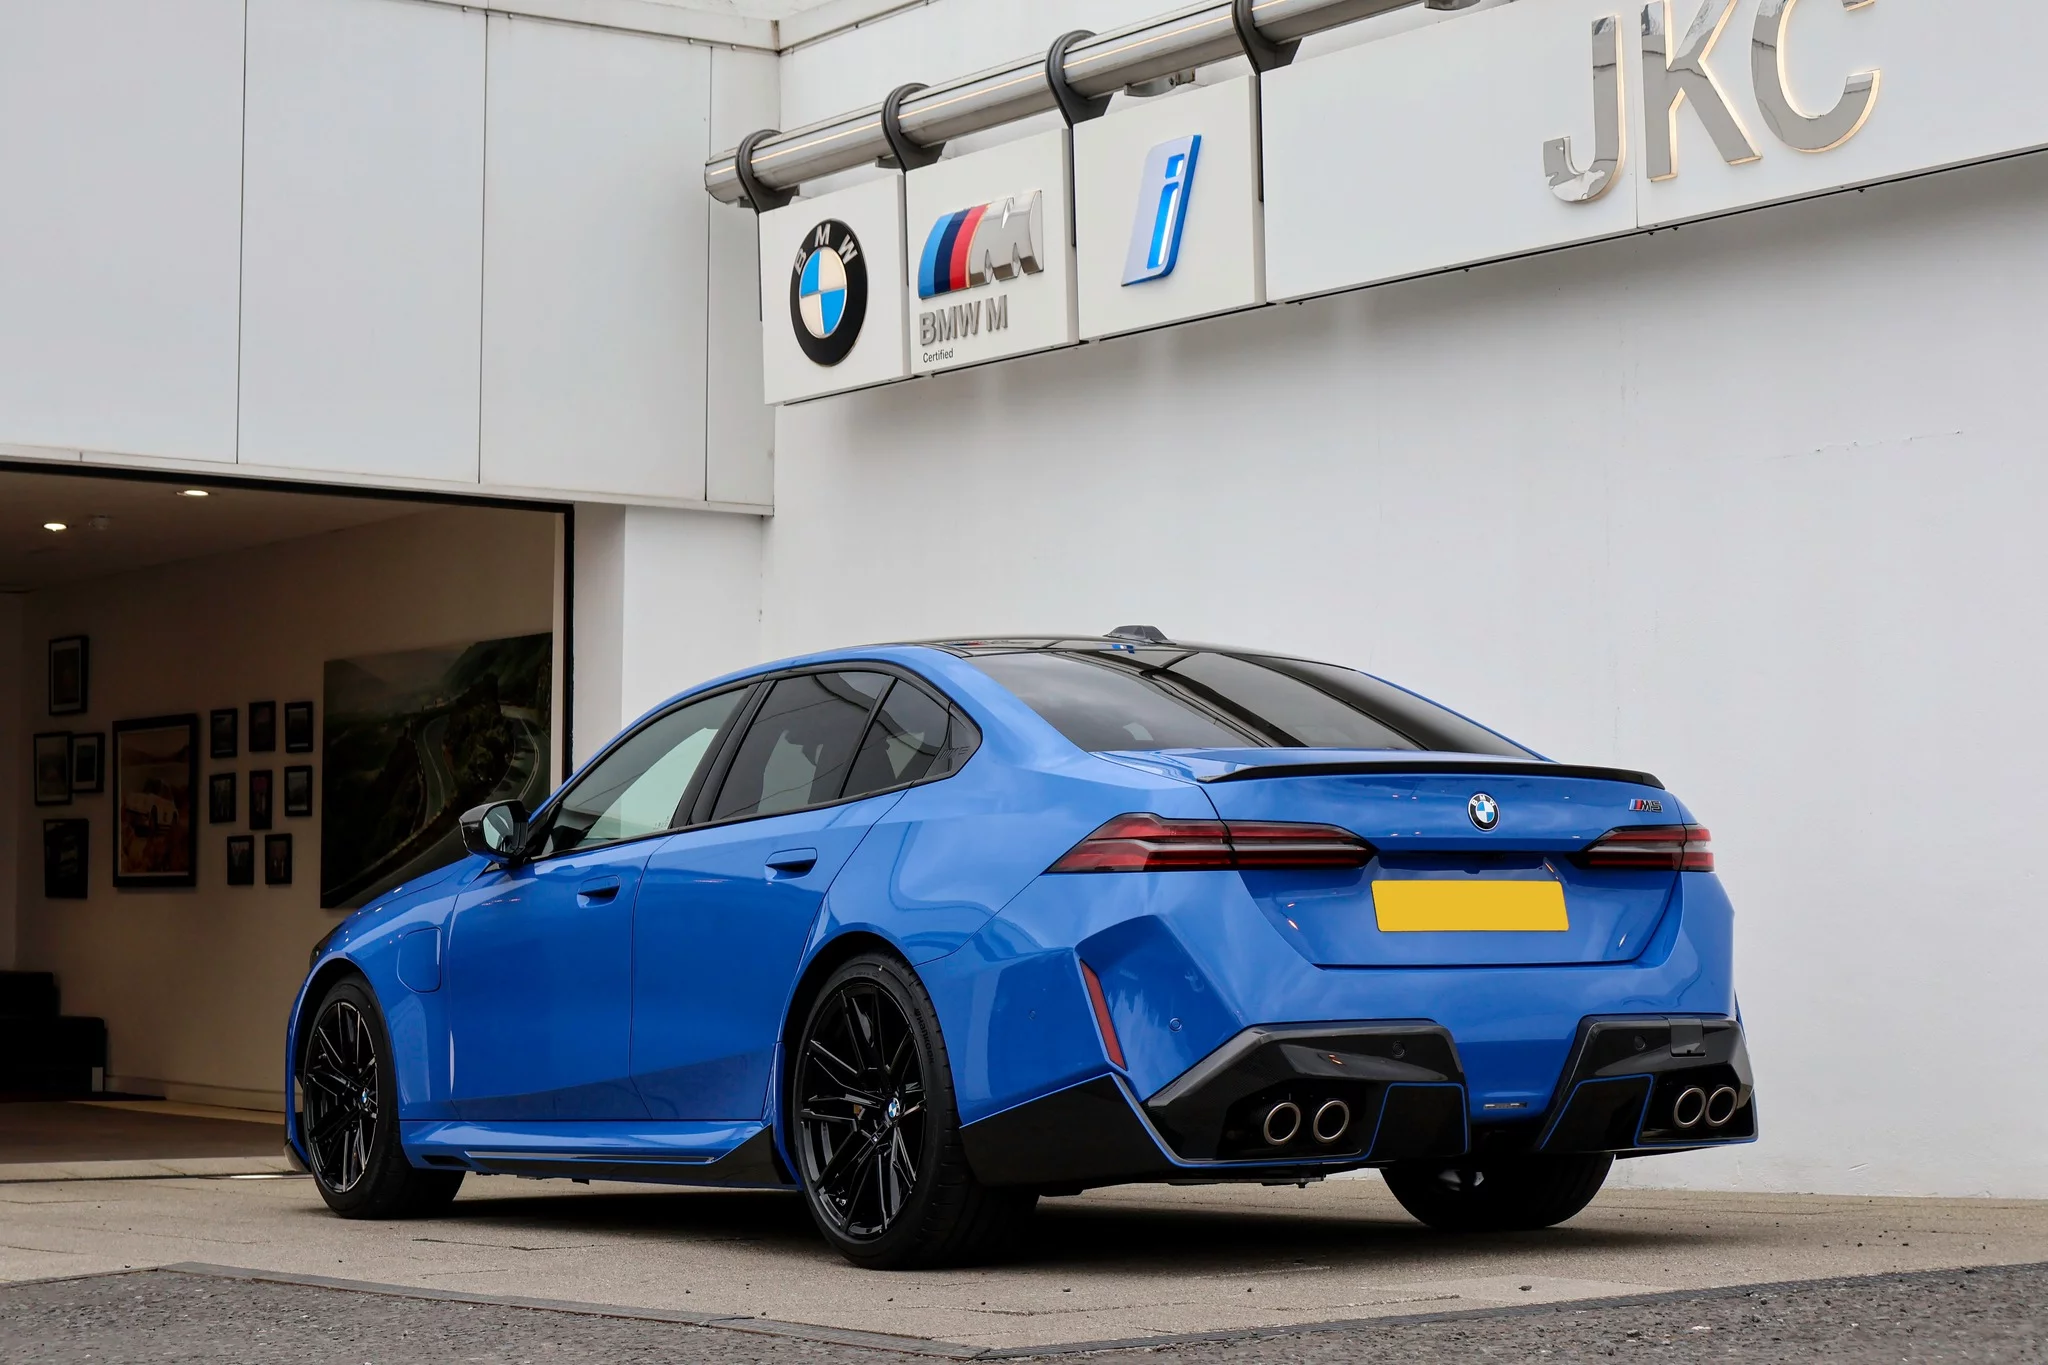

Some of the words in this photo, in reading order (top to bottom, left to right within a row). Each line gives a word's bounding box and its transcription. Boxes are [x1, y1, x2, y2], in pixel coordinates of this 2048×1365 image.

[1543, 0, 1880, 201] JKC
[794, 223, 858, 275] BMW
[919, 301, 981, 346] BMW
[986, 294, 1008, 332] M
[923, 347, 954, 363] Certified
